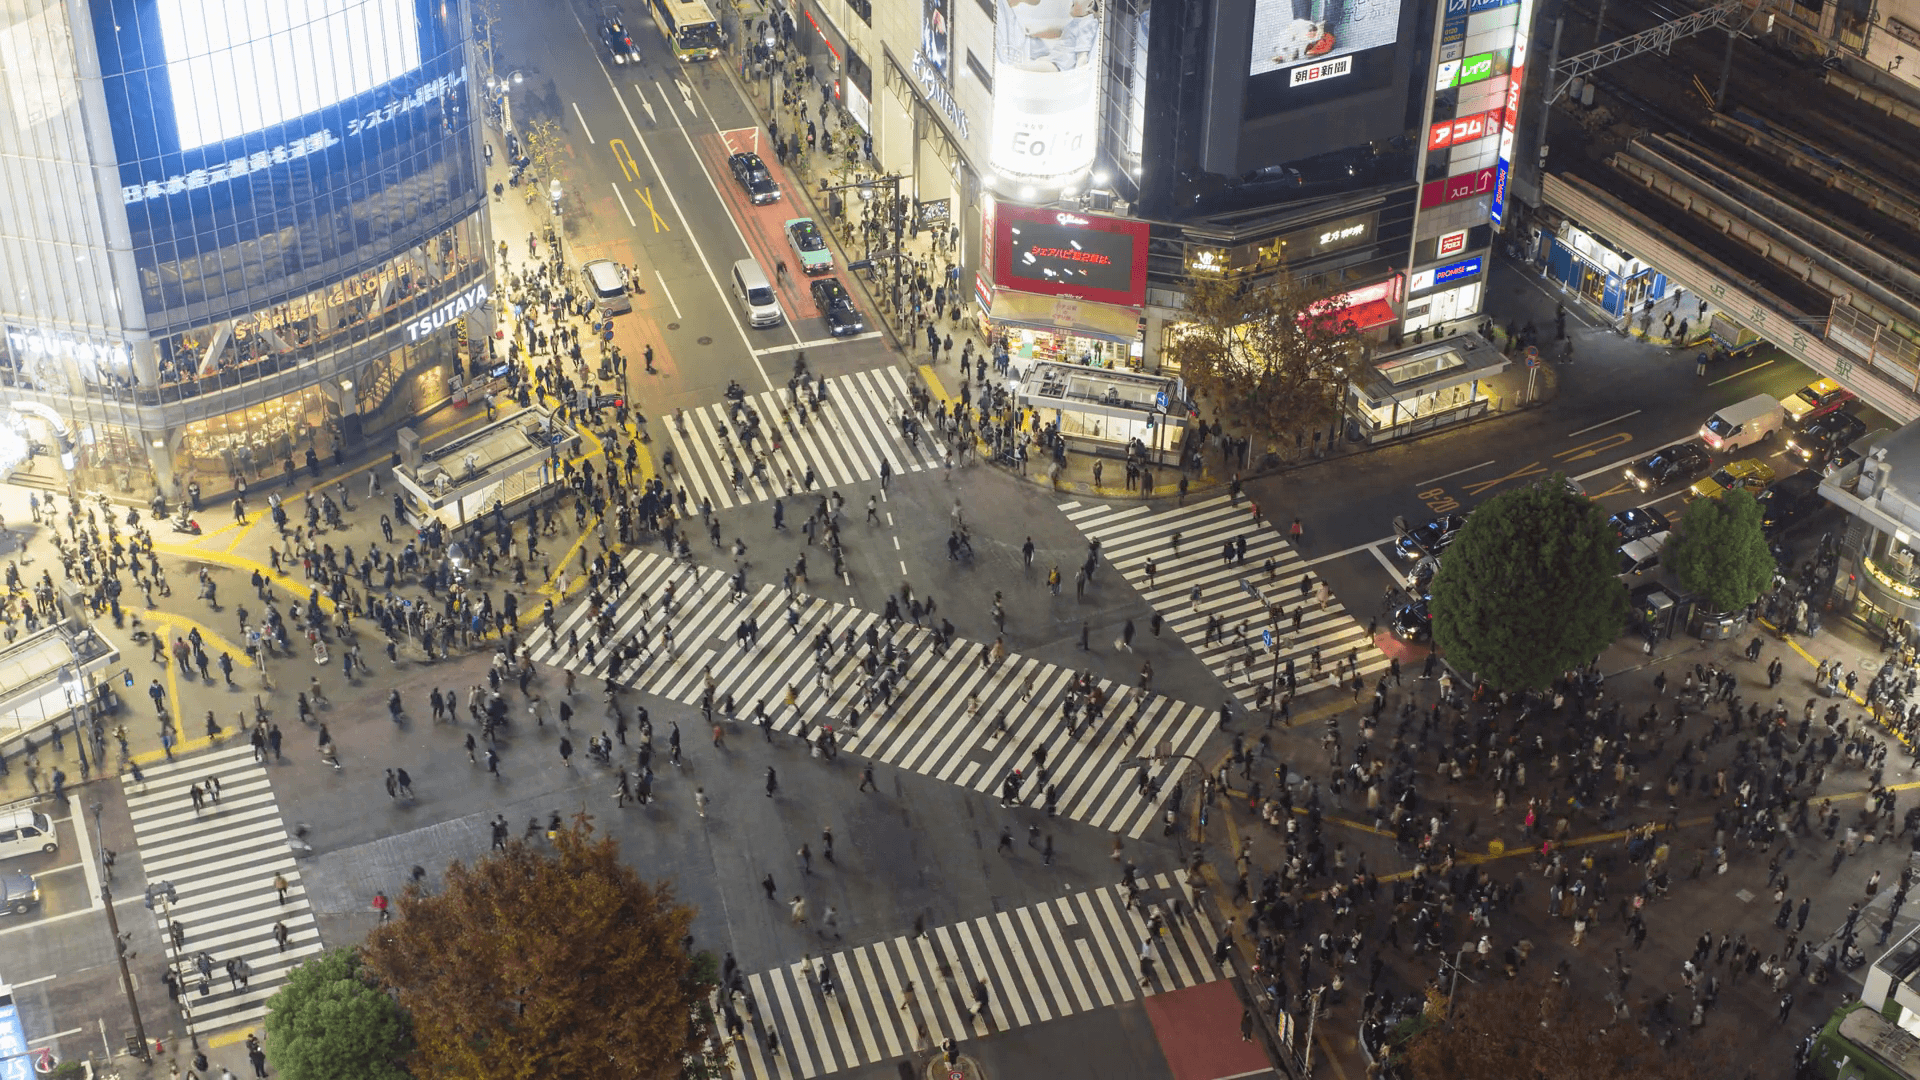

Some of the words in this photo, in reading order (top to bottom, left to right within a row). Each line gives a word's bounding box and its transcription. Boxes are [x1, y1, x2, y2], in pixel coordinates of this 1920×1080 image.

[1446, 50, 1457, 58] 6F
[1295, 61, 1347, 82] 朝日新聞
[1460, 59, 1491, 78] レイク
[1435, 120, 1482, 144] アコム
[1451, 186, 1469, 199] 入口
[1437, 265, 1465, 280] PROMISE
[235, 290, 345, 340] STARBUCKS
[407, 284, 488, 341] TSUTAYA
[9, 332, 129, 363] TSUTAYA
[1418, 488, 1460, 512] 8-20
